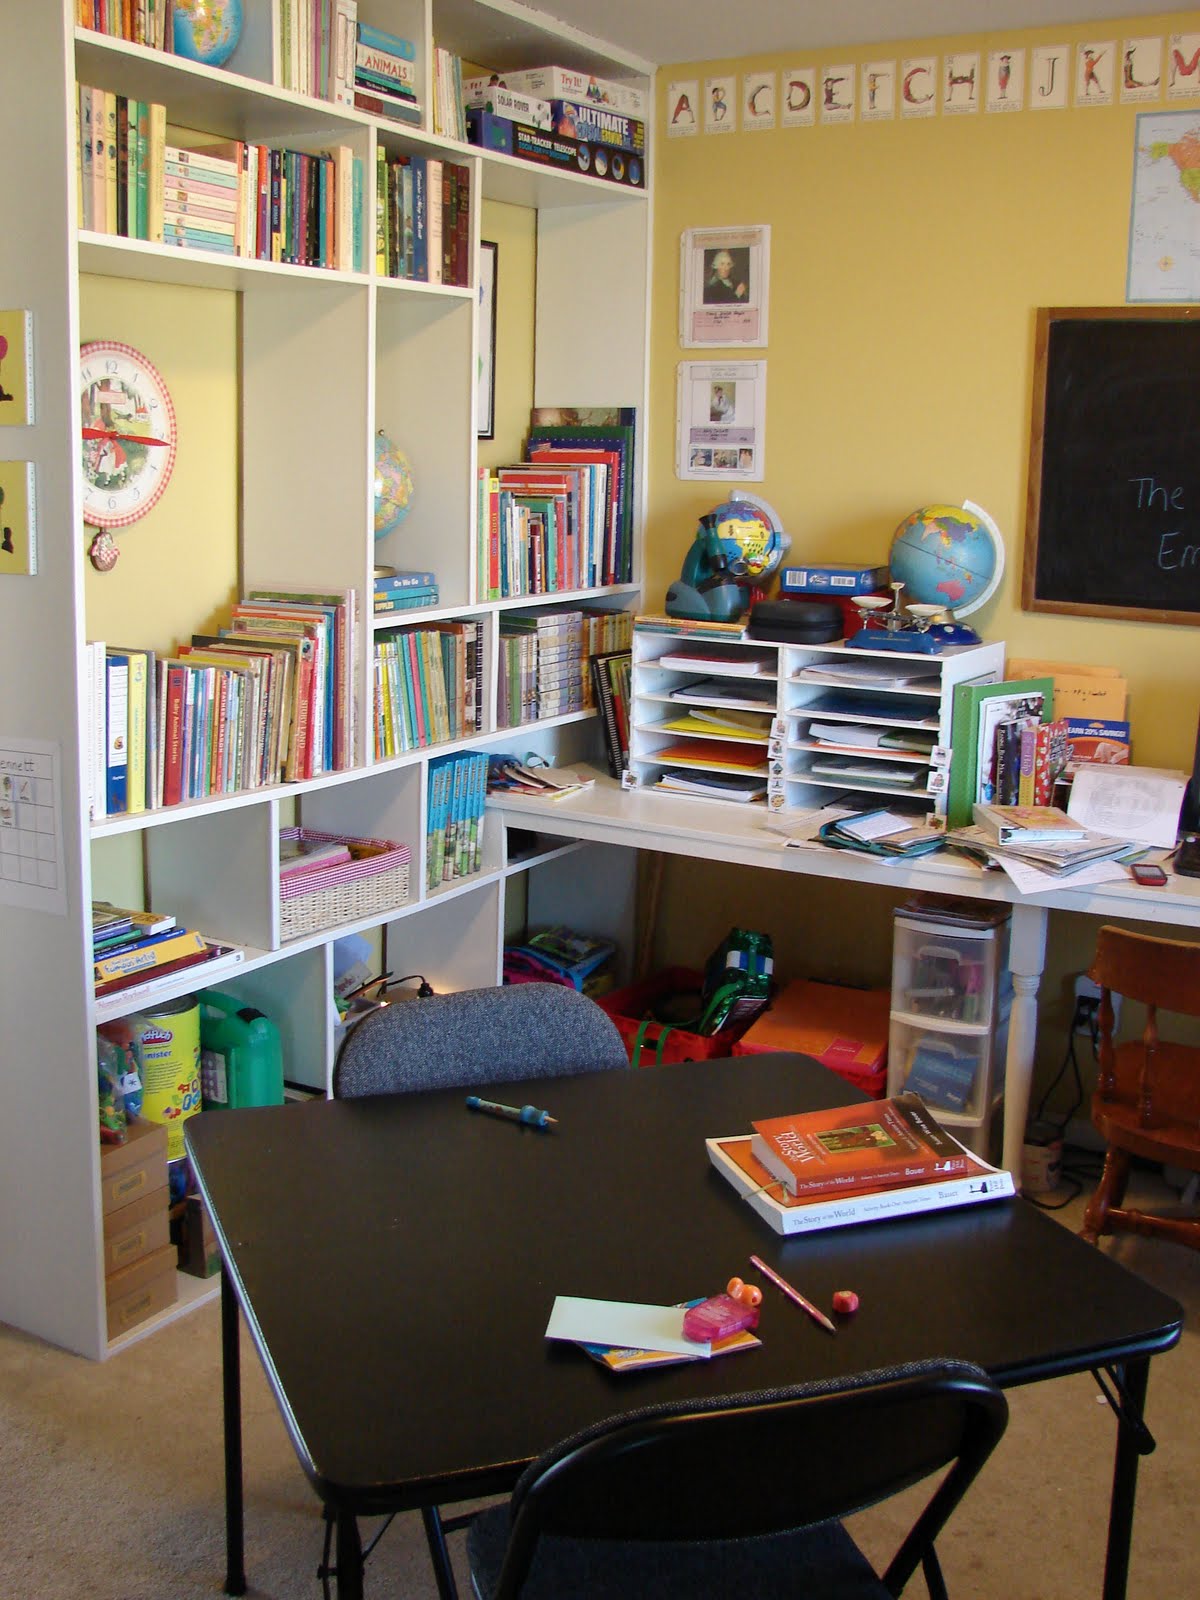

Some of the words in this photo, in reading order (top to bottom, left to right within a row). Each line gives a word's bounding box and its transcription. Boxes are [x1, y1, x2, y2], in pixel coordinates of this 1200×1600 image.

[364, 55, 407, 80] ANIMALS
[561, 74, 573, 88] Try
[1038, 57, 1060, 97] J
[497, 94, 513, 107] SOLAR
[513, 99, 530, 113] ROVER
[579, 106, 629, 136] ULTIMATE
[105, 360, 119, 375] 12
[107, 495, 117, 510] 6
[1127, 477, 1185, 512] The
[393, 578, 402, 587] On
[402, 578, 411, 586] We
[411, 577, 419, 586] Go
[172, 698, 180, 716] Baby
[300, 699, 308, 725] STORY
[172, 716, 180, 740] Animal
[1067, 727, 1084, 735] EARN
[1084, 728, 1099, 736] 20%
[1099, 729, 1127, 738] SAVINGS!
[298, 726, 307, 749] LAND
[171, 740, 179, 764] Stories
[1021, 754, 1032, 772] Help
[104, 962, 135, 974] Famous
[779, 1131, 816, 1163] World
[905, 1166, 926, 1176] Bauer
[809, 1181, 825, 1190] Story
[834, 1176, 855, 1185] World
[938, 1190, 958, 1200] Bauer
[793, 1218, 804, 1226] The
[803, 1215, 821, 1225] Story
[834, 1208, 856, 1218] World
